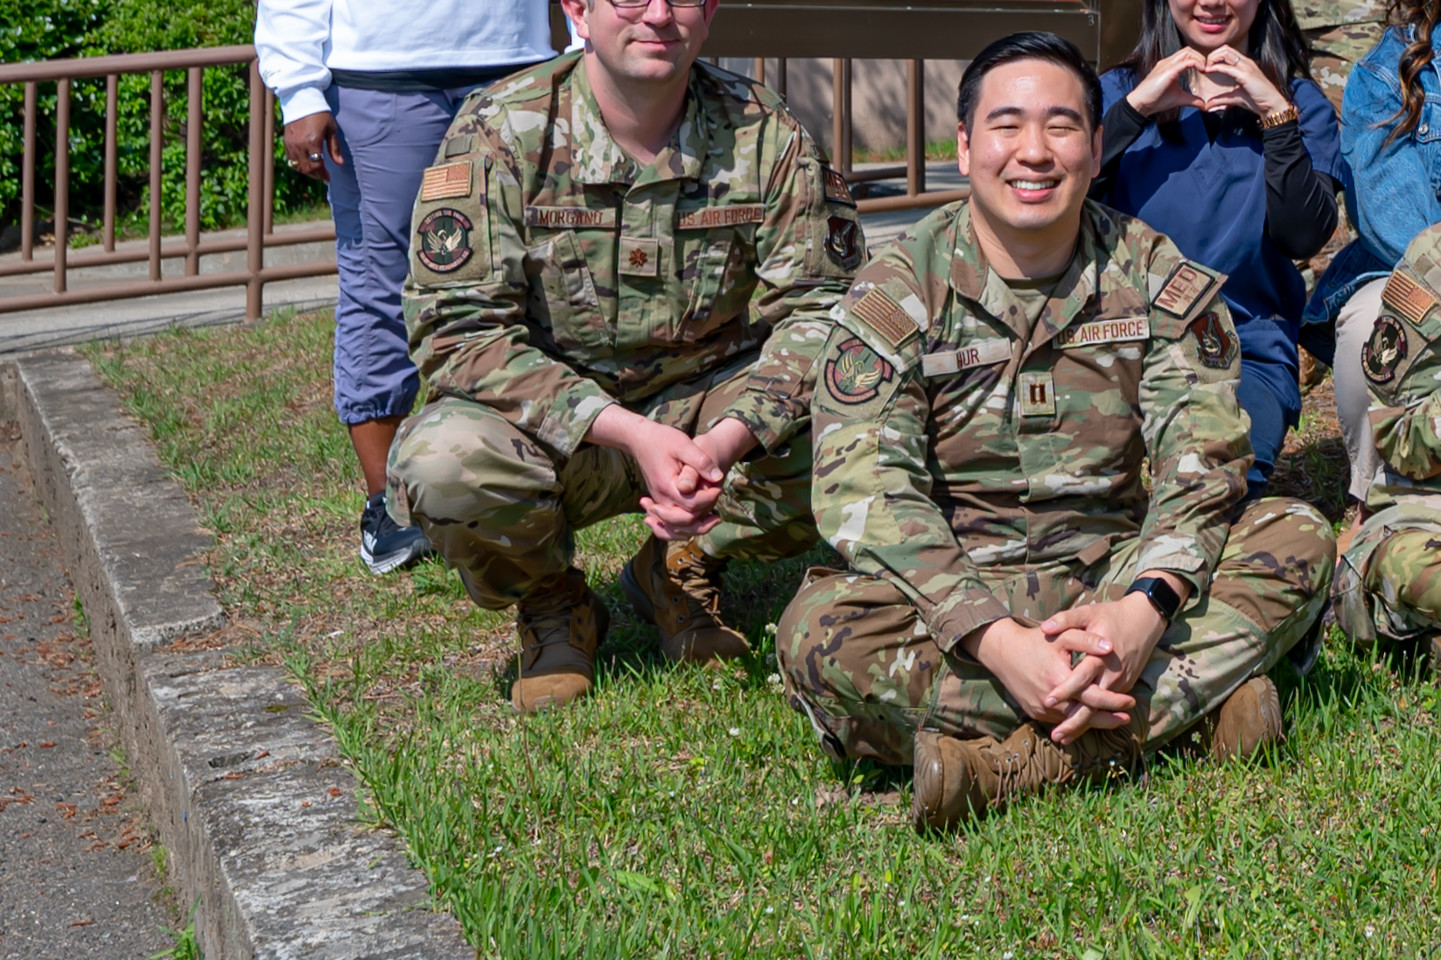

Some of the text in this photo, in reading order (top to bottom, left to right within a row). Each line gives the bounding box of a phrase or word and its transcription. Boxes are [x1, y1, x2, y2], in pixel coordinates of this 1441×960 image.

[538, 208, 604, 226] MORGANO
[700, 208, 721, 225] AIR
[723, 207, 763, 223] FORCE
[1157, 267, 1198, 310] MED
[1081, 324, 1103, 343] AIR
[1103, 320, 1144, 340] FORCE
[955, 348, 981, 369] HUR
